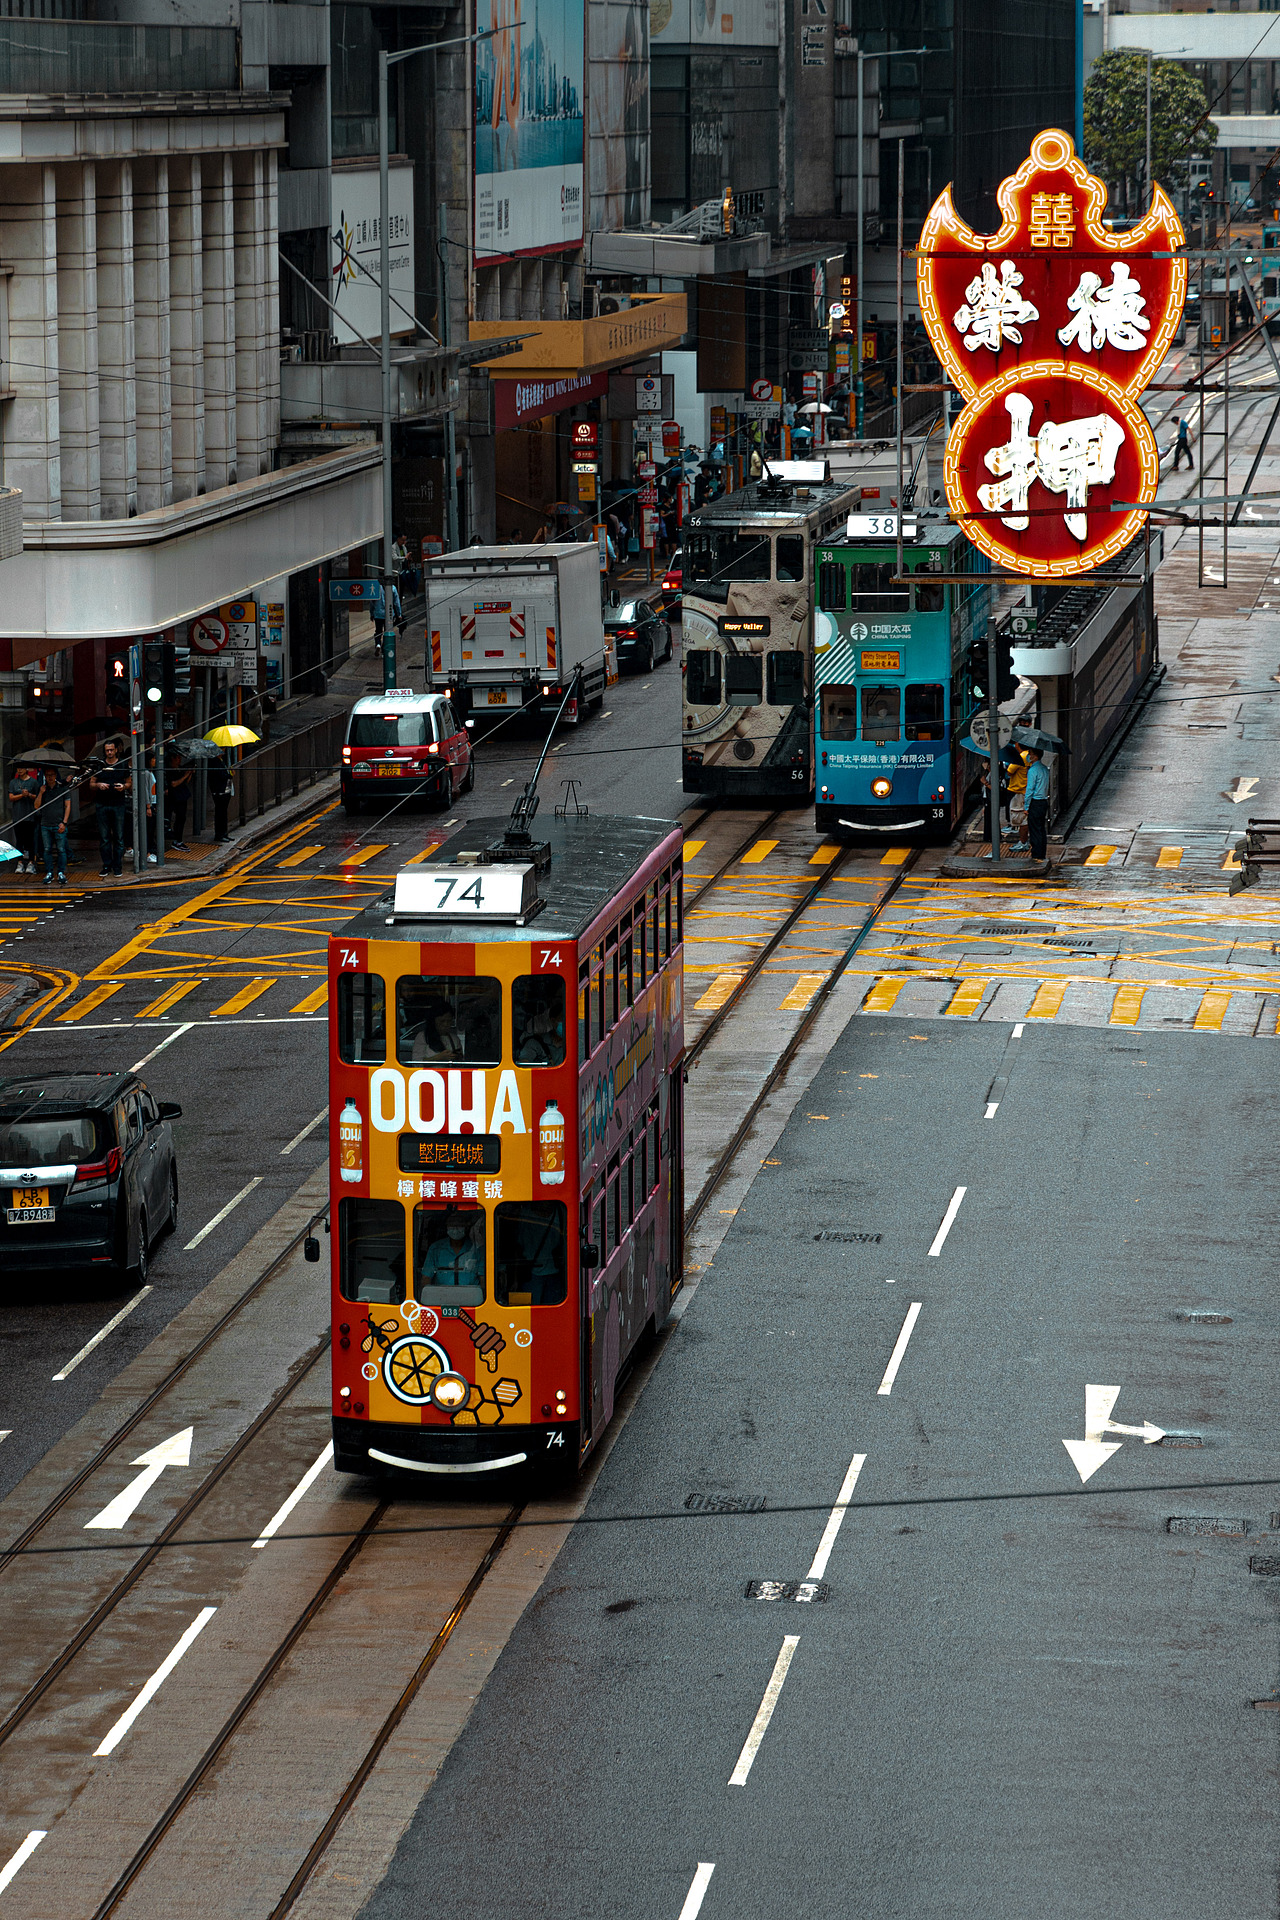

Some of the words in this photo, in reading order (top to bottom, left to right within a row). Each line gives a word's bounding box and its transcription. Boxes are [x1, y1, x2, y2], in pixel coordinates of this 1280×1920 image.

[977, 392, 1124, 541] 押
[690, 517, 701, 526] 56
[868, 518, 894, 534] 38
[821, 551, 833, 562] 38
[928, 551, 941, 562] 38
[243, 625, 249, 633] 7
[724, 623, 741, 631] Happy
[743, 623, 764, 631] Valley
[243, 639, 249, 647] 7
[791, 770, 804, 780] 56
[932, 809, 944, 818] 38
[434, 877, 485, 909] 74
[340, 950, 359, 967] 74
[540, 951, 562, 967] 74
[370, 1069, 526, 1134] OOHA
[418, 1143, 484, 1165] 堅尼地城
[23, 1189, 38, 1198] LB
[397, 1179, 504, 1199] 檸檬蜂蜜號
[20, 1198, 43, 1207] 639
[442, 1308, 458, 1316] 038
[546, 1432, 565, 1448] 74
